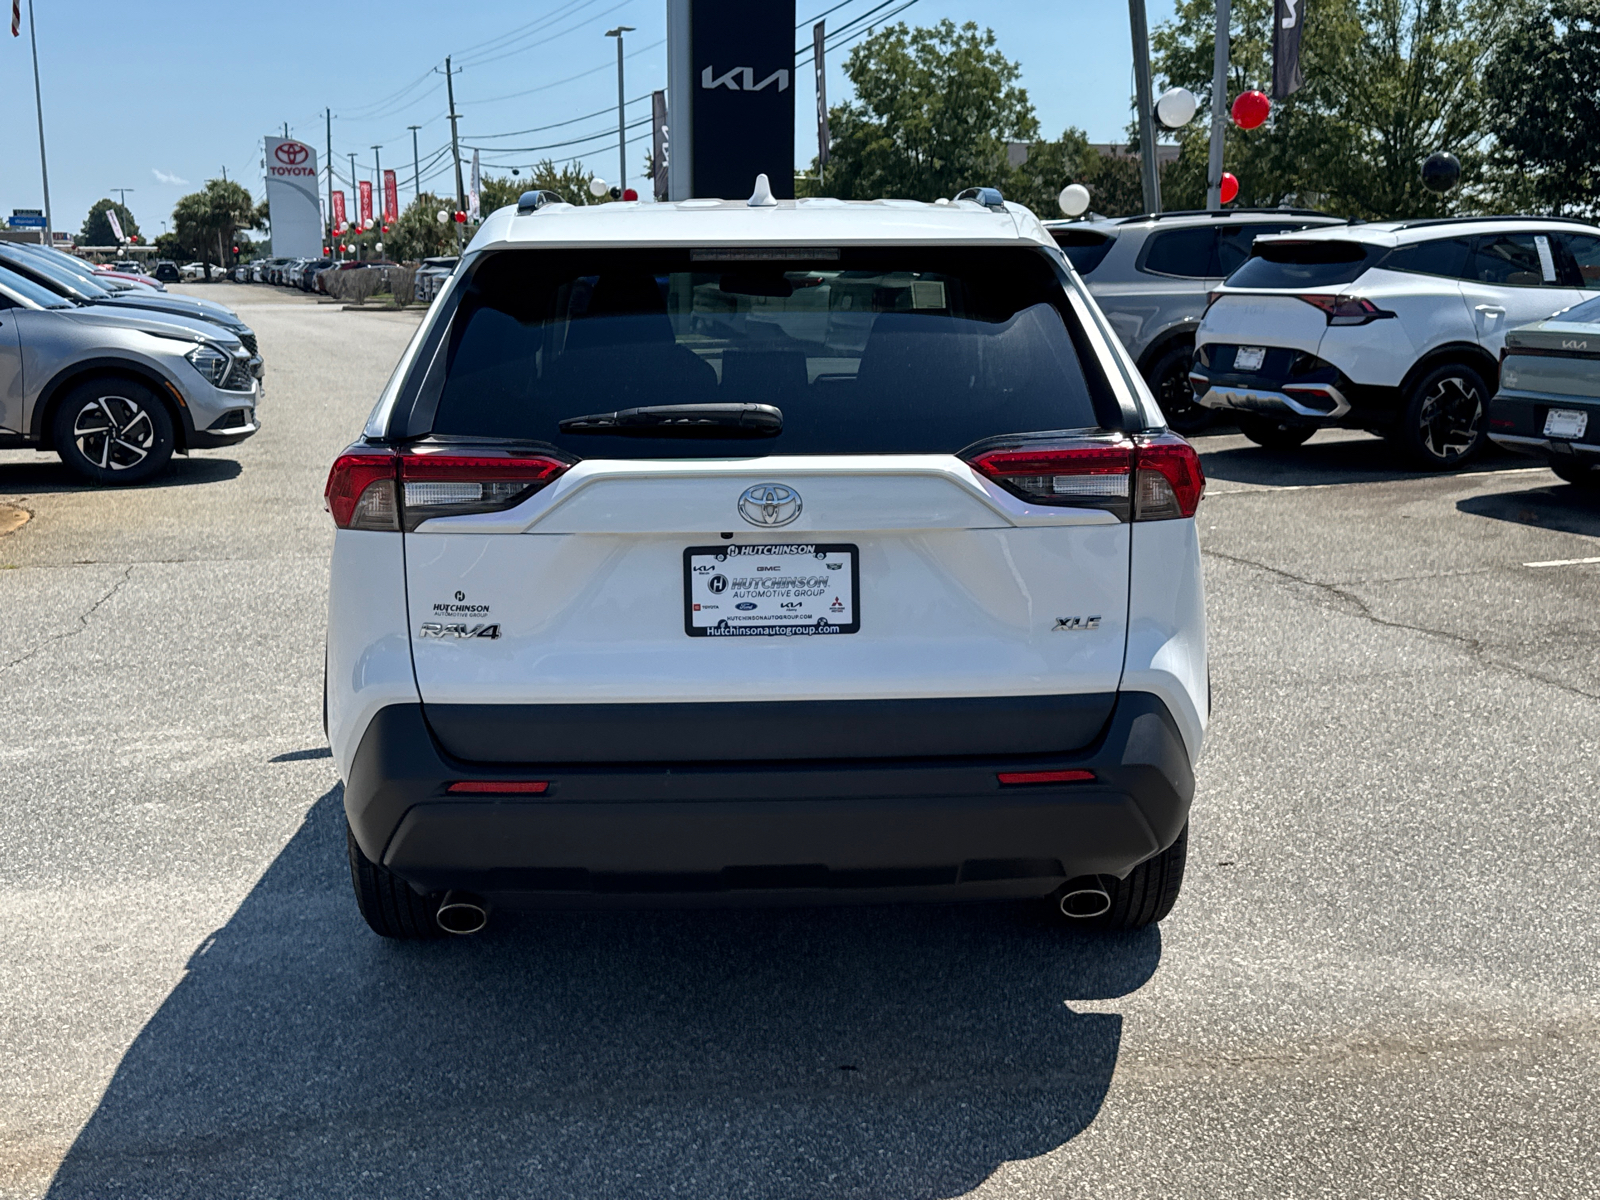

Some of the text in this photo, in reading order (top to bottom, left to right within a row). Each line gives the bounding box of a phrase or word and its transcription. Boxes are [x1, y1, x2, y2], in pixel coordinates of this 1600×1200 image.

[701, 65, 789, 93] KIA
[270, 166, 315, 176] TOYOTA
[1562, 340, 1588, 350] KIA
[740, 545, 816, 555] HUTCHINSON
[731, 576, 829, 590] HUTCHINSON
[732, 588, 826, 599] AUTOMOTIVE GROUP
[433, 604, 491, 612] HUTCHINSON
[1051, 614, 1102, 632] XLE
[419, 621, 502, 640] RAV4
[706, 625, 840, 637] Hutchinsonautogroup.com
